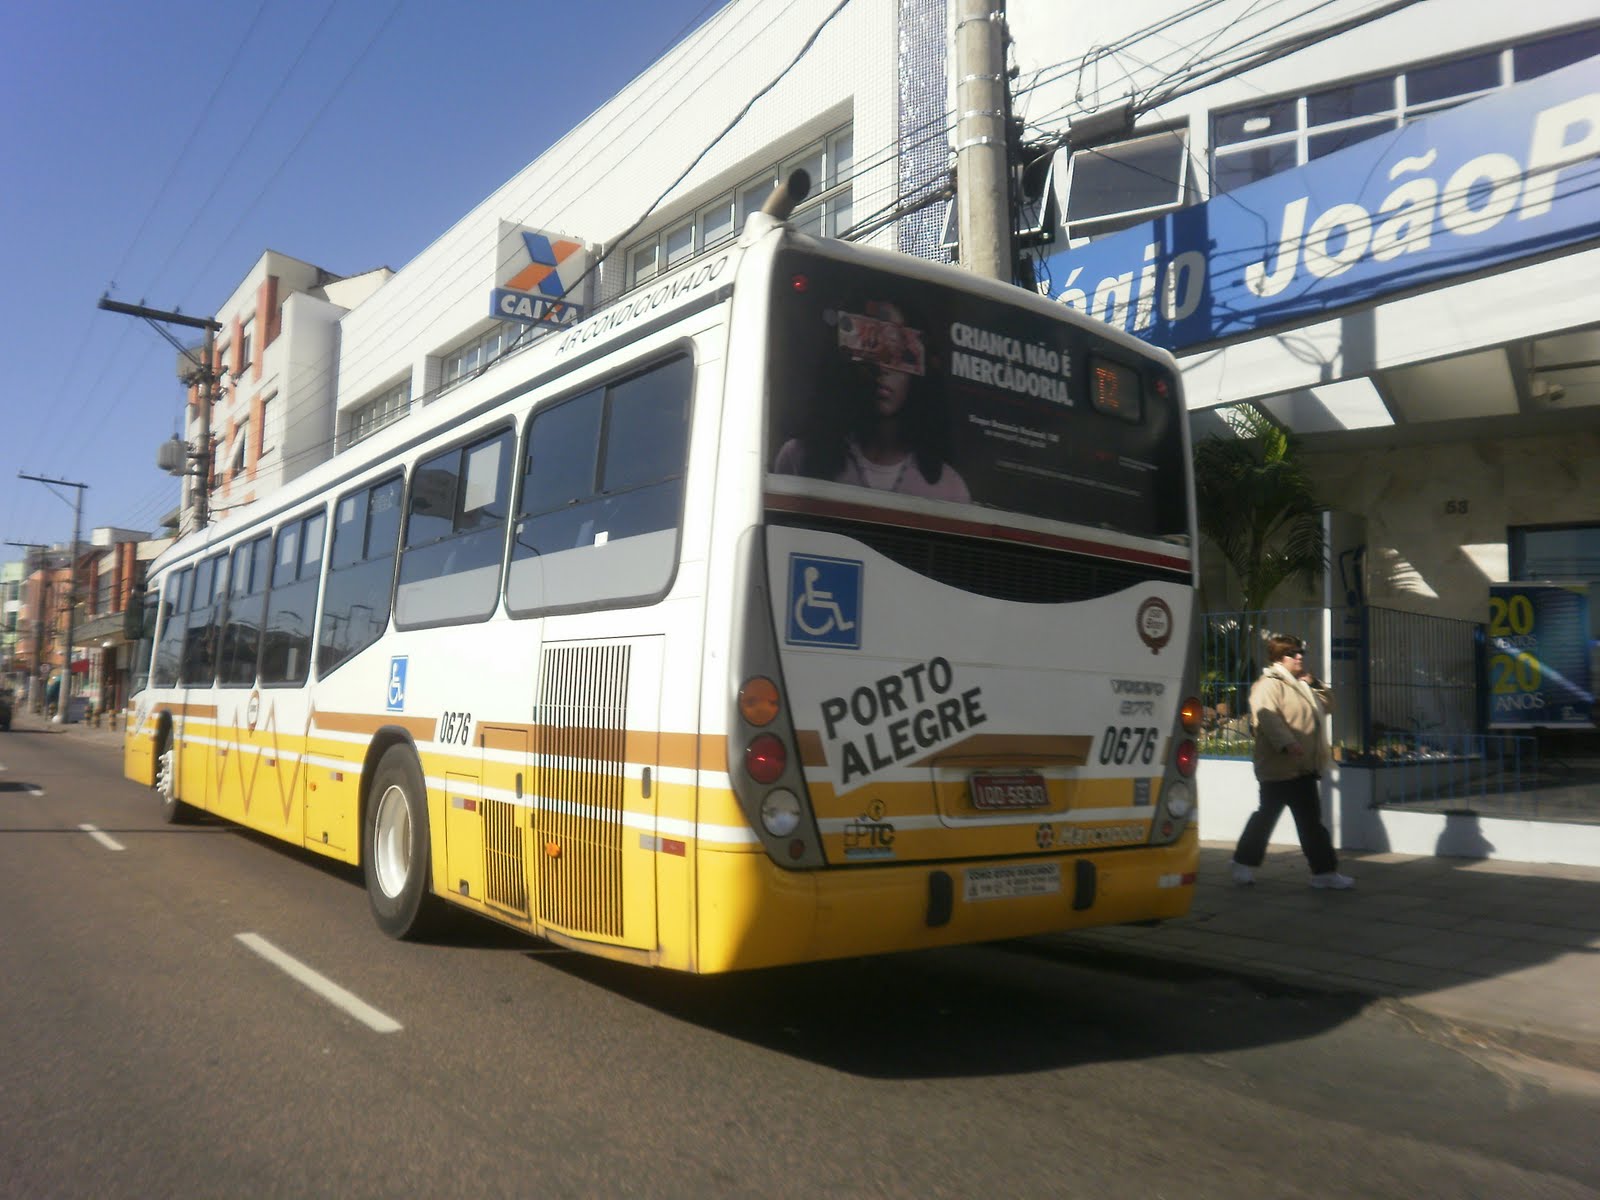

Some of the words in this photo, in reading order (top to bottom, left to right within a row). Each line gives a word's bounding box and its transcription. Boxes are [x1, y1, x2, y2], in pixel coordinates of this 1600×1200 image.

[501, 295, 577, 326] CAIXA
[555, 329, 583, 356] AR
[581, 255, 729, 344] CONDICIONADO
[951, 321, 1024, 365] CRIANÇA
[1024, 342, 1059, 376] NÃO
[1061, 349, 1072, 378] É
[952, 351, 1075, 408] MERCADORIA.
[1489, 594, 1535, 637] 20
[1490, 653, 1542, 694] 20
[820, 656, 953, 741] PORTO
[1496, 692, 1546, 712] ANOS
[440, 711, 472, 746] 0676
[841, 686, 988, 785] ALEGRE
[1100, 725, 1159, 766] 0676
[844, 823, 895, 847] EPTC
